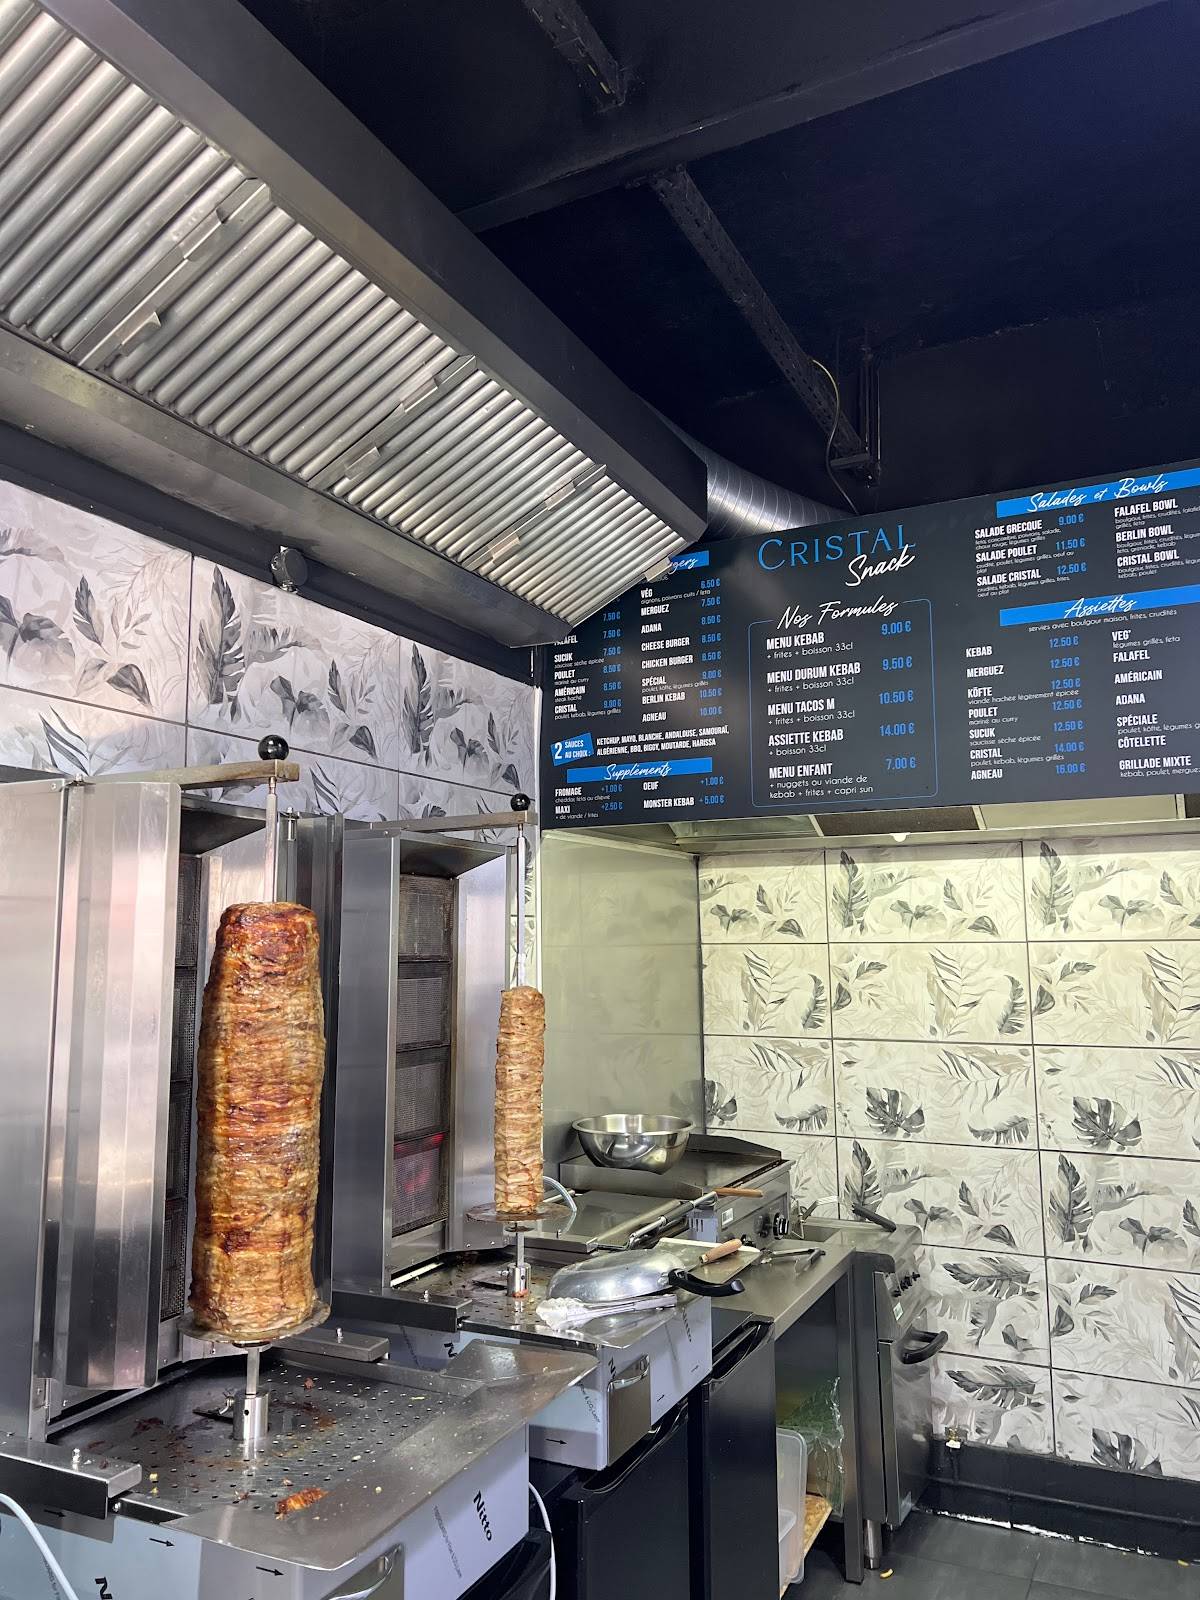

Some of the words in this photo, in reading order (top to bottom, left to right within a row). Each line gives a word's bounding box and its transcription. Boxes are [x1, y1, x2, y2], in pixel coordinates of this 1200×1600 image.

[1027, 489, 1086, 512] Salades
[1095, 488, 1108, 500] et
[1114, 474, 1168, 498] Bowls
[1115, 503, 1151, 517] FALAFEL
[1153, 498, 1178, 510] BOWL
[1058, 515, 1077, 525] 9.00
[975, 525, 1005, 539] SALADE
[1007, 520, 1042, 535] GRECQUE
[1116, 529, 1146, 542] BERLIN
[1149, 525, 1174, 537] BOWL
[758, 525, 916, 571] CRISTAL
[1055, 539, 1077, 550] 11.50
[976, 549, 1006, 563] SALADE
[1008, 545, 1038, 559] POULET
[1117, 554, 1152, 567] CRISTAL
[1154, 549, 1179, 562] BOWL
[845, 544, 915, 586] Snack
[1056, 564, 1078, 575] 12.50
[977, 573, 1007, 587] SALADE
[1009, 569, 1041, 582] CRISTAL
[641, 604, 669, 616] MERGUEZ
[777, 606, 812, 629] Nos
[818, 595, 898, 625] Formules
[1064, 595, 1138, 619] Assiettes
[641, 623, 662, 634] ADANA
[881, 621, 903, 635] 9.00
[642, 639, 664, 651] CHEESE
[666, 637, 689, 648] BURGER
[766, 636, 792, 650] MENU
[794, 632, 824, 646] KEBAB
[774, 649, 792, 658] frites
[802, 645, 832, 655] boisson
[836, 642, 853, 651] 33cl
[966, 646, 992, 658] KEBAB
[1113, 650, 1150, 662] FALAFEL
[554, 653, 572, 662] SUCUK
[642, 658, 667, 669] CHICKEN
[669, 655, 693, 666] BURGER
[882, 657, 903, 670] 9.50
[554, 670, 575, 679] POULET
[767, 670, 793, 684] MENU
[795, 666, 827, 681] DURUM
[830, 662, 860, 676] KEBAB
[967, 665, 1004, 678] MERGUEZ
[1114, 670, 1162, 684] AMÉRICAIN
[642, 676, 666, 686] SPÉCIAL
[775, 684, 793, 692] frites
[803, 679, 833, 690] boisson
[836, 677, 854, 686] 33cl
[555, 686, 585, 697] AMÉRICAIN
[642, 694, 663, 705] BERLIN
[665, 691, 685, 702] KEBAB
[880, 692, 905, 704] 10.50
[968, 687, 992, 698] KÖFTE
[1116, 693, 1145, 705] ADANA
[555, 704, 577, 714] CRISTAL
[768, 702, 793, 715] MENU
[795, 699, 824, 713] TACOS
[827, 698, 834, 709] M
[969, 707, 998, 719] POULET
[642, 712, 667, 722] AGNEAU
[775, 716, 793, 725] frites
[804, 712, 834, 722] boisson
[837, 710, 854, 719] 33cl
[1117, 714, 1157, 727] SPÉCIALE
[880, 724, 905, 737] 14.00
[969, 728, 995, 739] SUCUK
[565, 740, 583, 748] SAUCES
[692, 738, 716, 747] HARISSA
[769, 732, 810, 746] ASSIETTE
[812, 729, 843, 742] KEBAB
[1118, 735, 1166, 749] CÔTELETTE
[555, 742, 562, 759] 2
[776, 746, 806, 756] boisson
[809, 744, 826, 753] 33cl
[970, 748, 1002, 759] CRISTAL
[886, 758, 907, 770] 7.00
[1119, 758, 1161, 770] GRILLADE
[1162, 755, 1191, 768] MIXTE
[604, 762, 672, 780] Suppléments
[770, 765, 795, 778] MENU
[797, 763, 832, 777] ENFANT
[971, 769, 1003, 780] AGNEAU
[644, 781, 659, 790] OEUF
[777, 779, 809, 789] nuggets
[812, 778, 822, 786] ou
[825, 776, 853, 785] viande
[856, 775, 867, 783] de
[555, 787, 582, 796] FROMAGE
[770, 789, 795, 798] kebab
[805, 788, 824, 796] frites
[835, 786, 857, 796] capri
[644, 798, 672, 809] MONSTER
[674, 797, 694, 806] KEBAB
[556, 806, 570, 815] MAXI
[473, 1490, 492, 1541] Nitto
